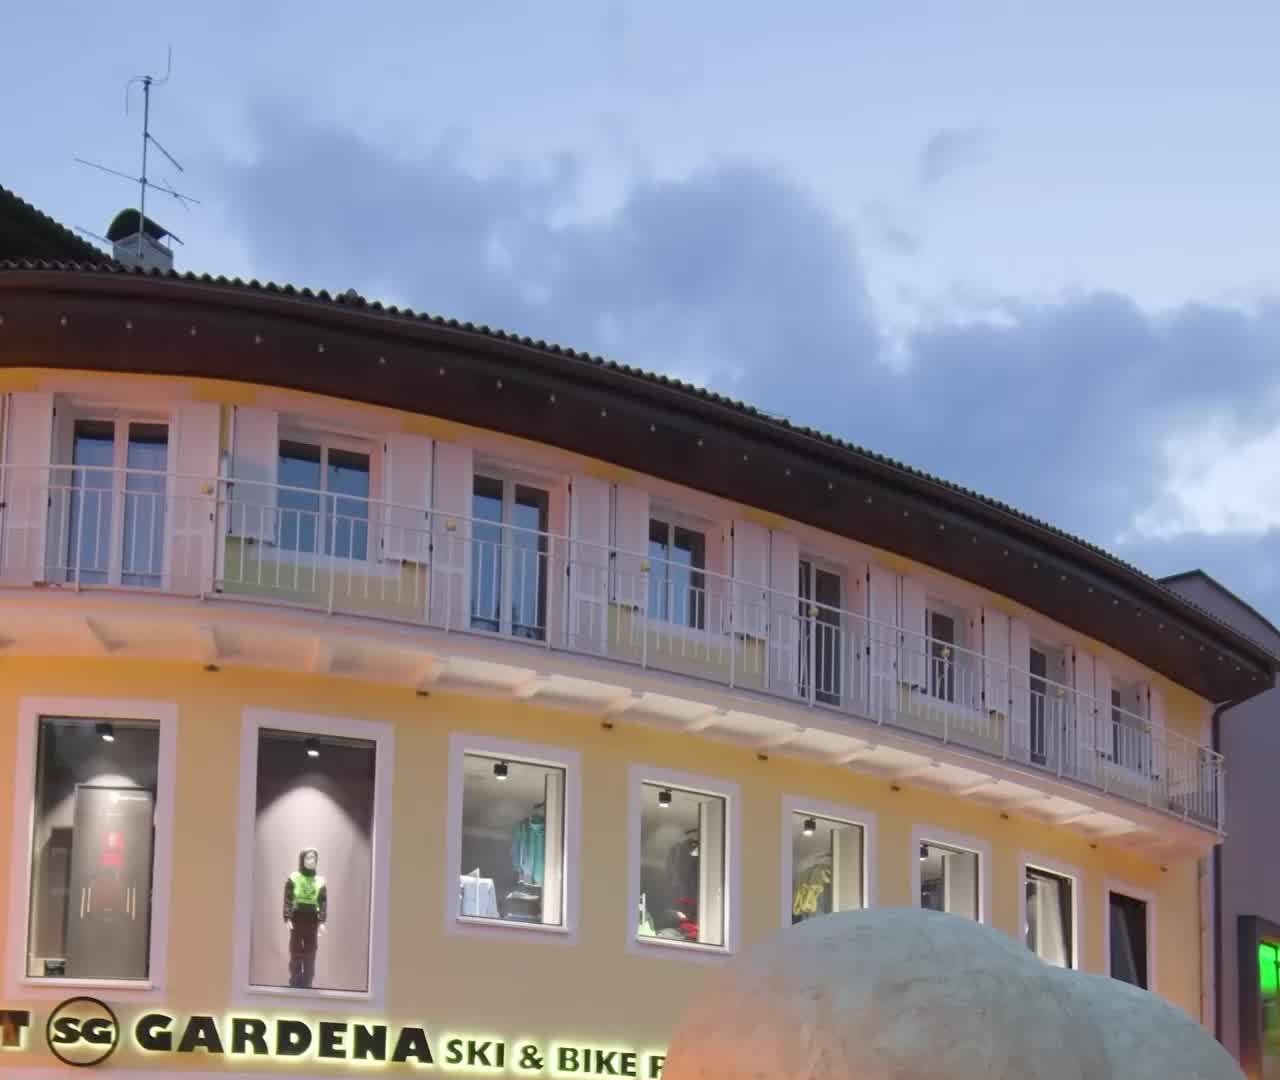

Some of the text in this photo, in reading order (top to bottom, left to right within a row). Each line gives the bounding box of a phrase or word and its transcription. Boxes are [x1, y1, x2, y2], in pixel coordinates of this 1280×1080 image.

[51, 1016, 113, 1045] SG
[134, 1012, 435, 1065] GARDENA
[445, 1038, 505, 1068] SKI
[518, 1044, 545, 1071] &
[557, 1046, 637, 1078] BIKE
